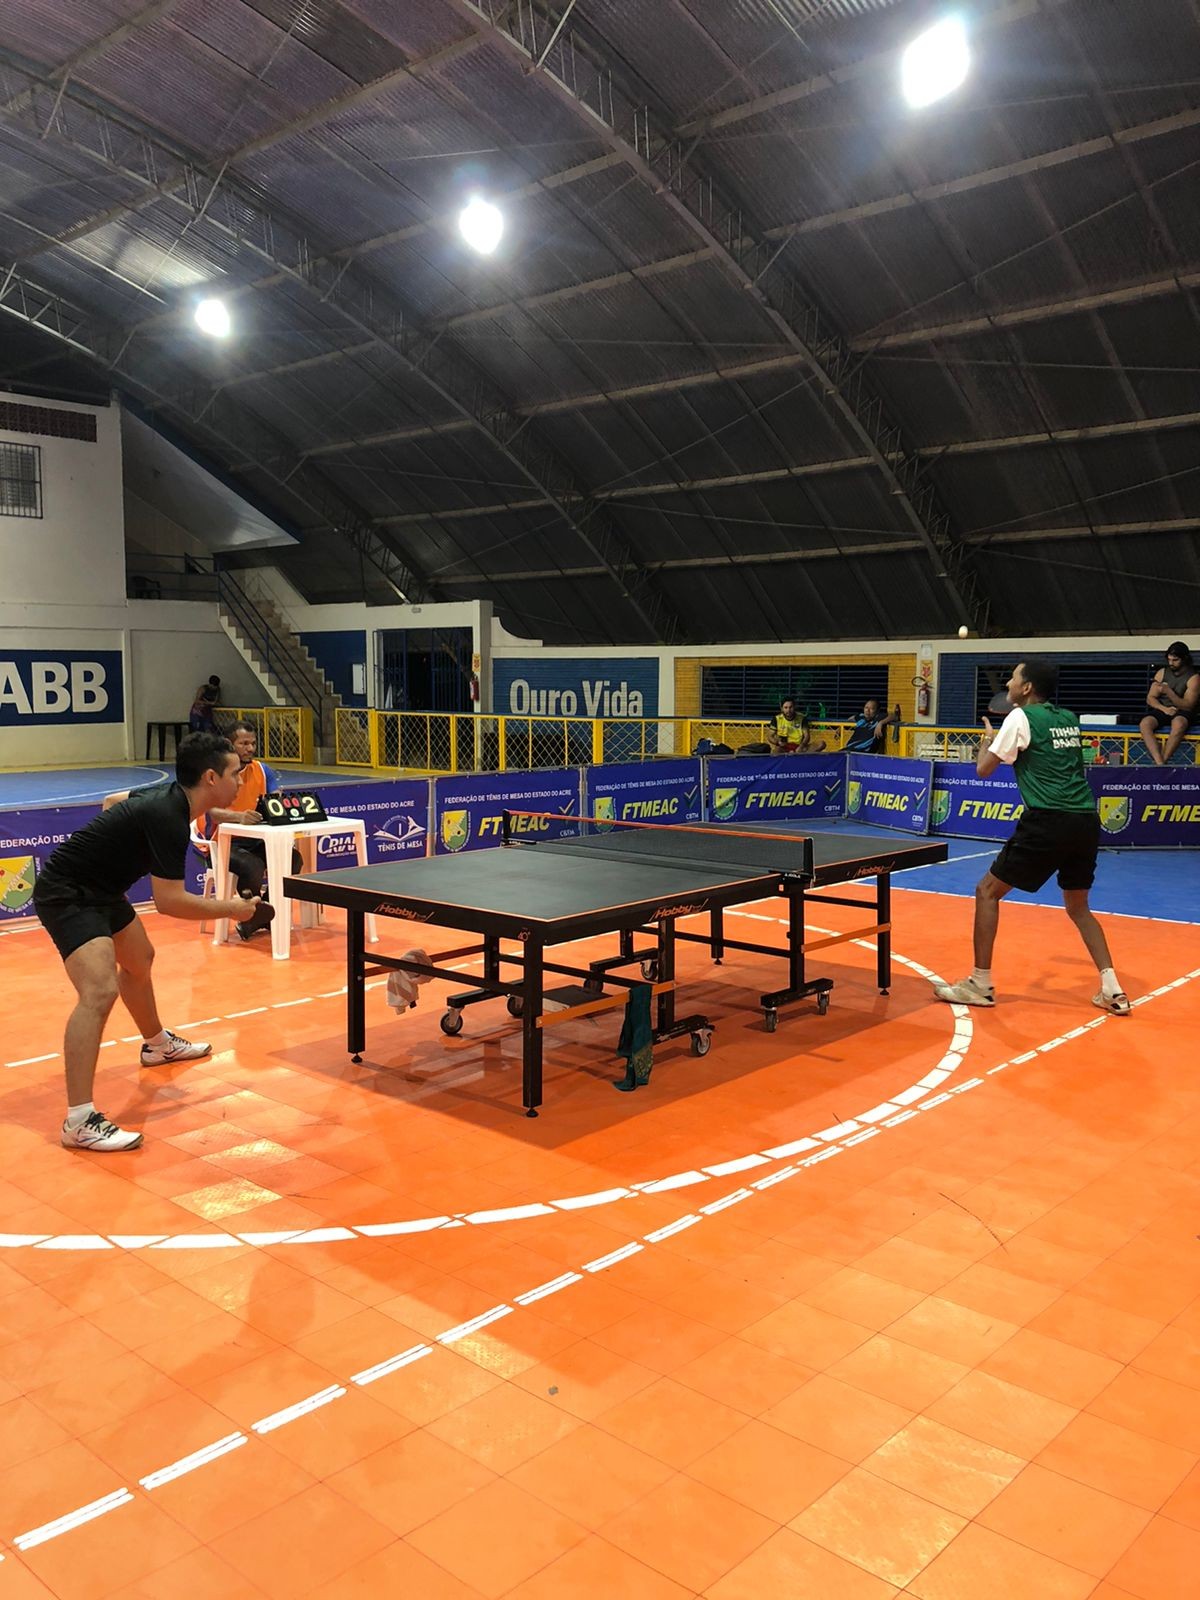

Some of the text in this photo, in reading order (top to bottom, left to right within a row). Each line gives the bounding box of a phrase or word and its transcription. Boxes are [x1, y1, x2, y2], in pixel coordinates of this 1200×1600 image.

[509, 678, 644, 717] Ouro Vida
[969, 779, 983, 787] TÊNIS
[1102, 783, 1141, 791] FEDERAÇÃO
[1152, 783, 1170, 791] TÊNIS
[444, 794, 477, 804] FEDERAÇÃO
[478, 793, 485, 802] DE
[486, 792, 501, 801] TÊNIS
[509, 792, 524, 800] MESA
[532, 790, 550, 798] ESTADO
[745, 790, 817, 809] FTMEAC
[864, 790, 909, 812] FTMEAC
[268, 798, 284, 816] 0
[302, 796, 319, 813] 2
[340, 805, 357, 813] MESA
[357, 804, 366, 812] DO
[367, 802, 389, 811] ESTADO
[390, 801, 399, 809] DO
[400, 800, 415, 808] ACRE
[622, 797, 679, 820] FTMEAC
[958, 799, 1024, 821] FTMEA
[0, 835, 51, 849] EDERAÇÃO
[52, 834, 65, 844] DE
[377, 840, 423, 852] TÊNIS DE MESA
[378, 904, 417, 920] Hobby
[654, 904, 692, 919] Hobby
